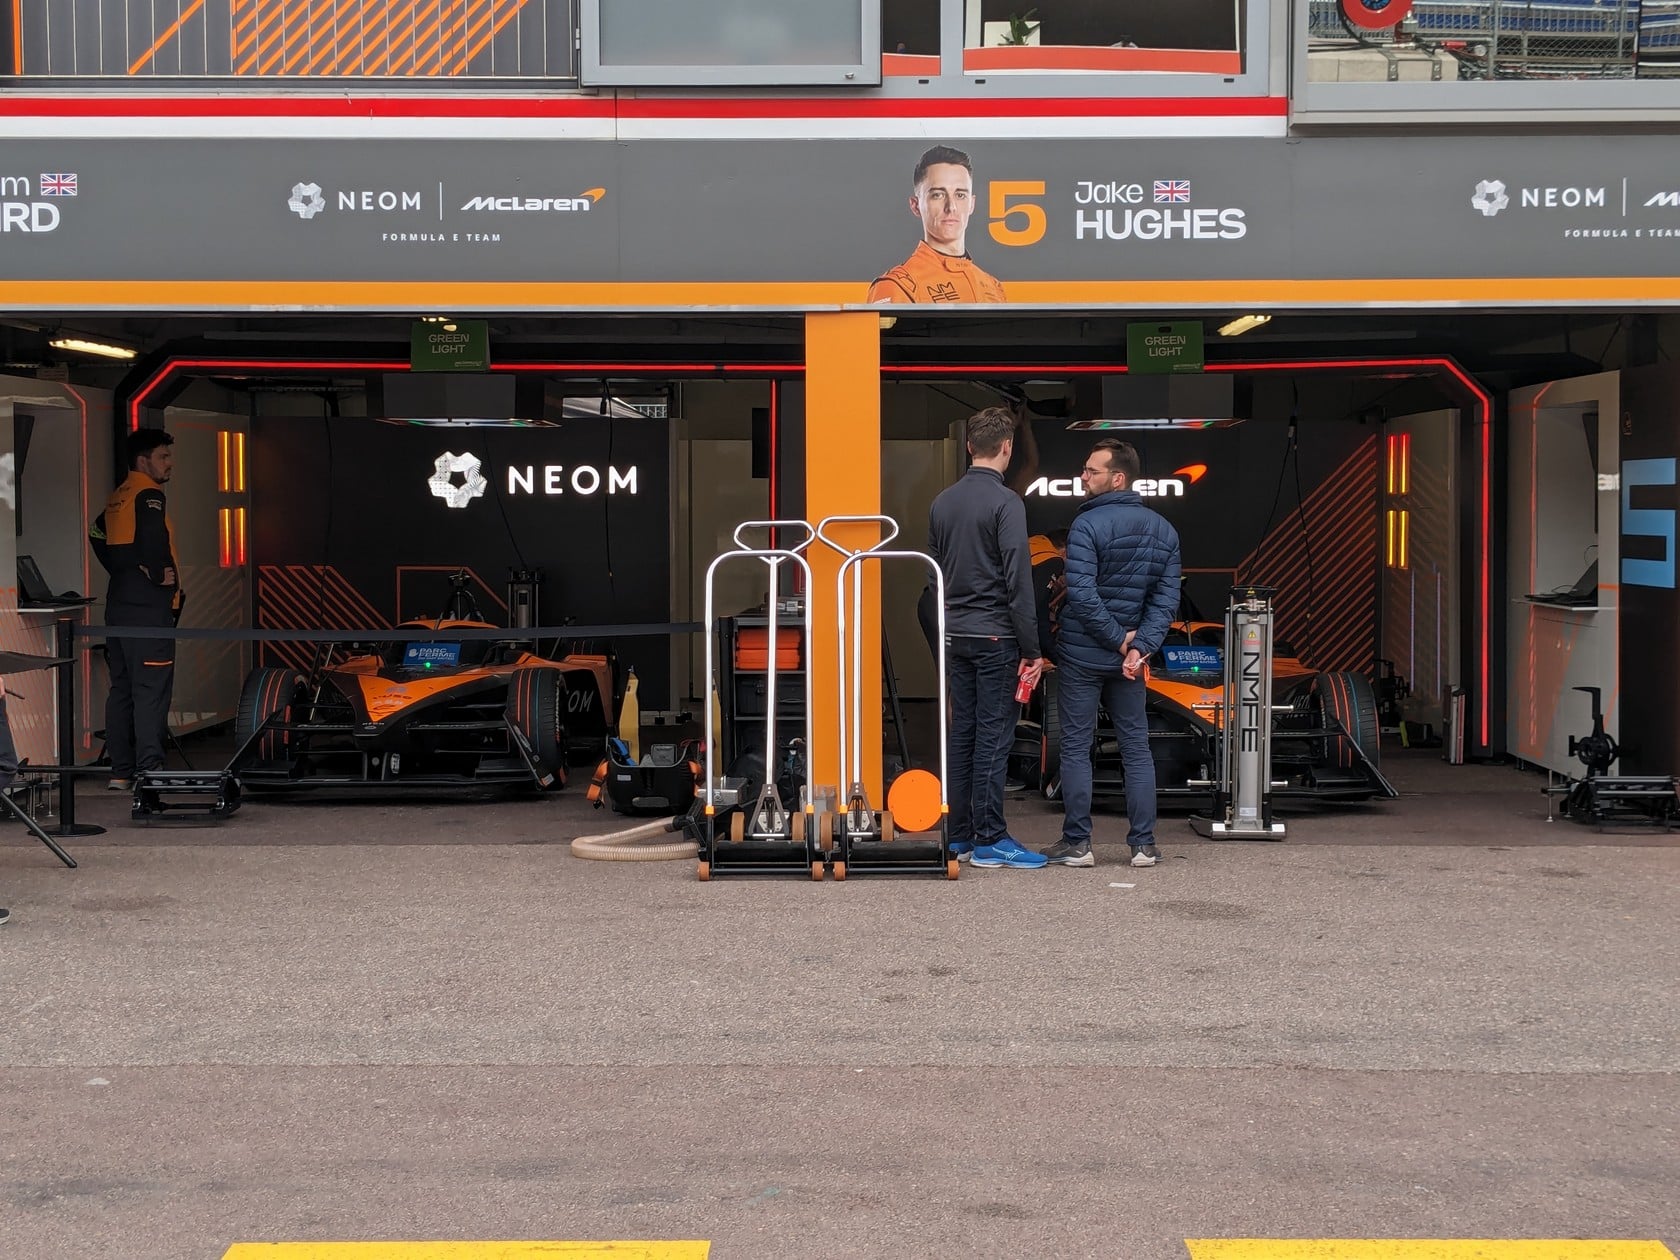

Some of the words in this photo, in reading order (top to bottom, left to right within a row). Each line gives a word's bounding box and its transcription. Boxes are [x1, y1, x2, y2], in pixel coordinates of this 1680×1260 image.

[338, 191, 421, 211] NEOM
[460, 196, 590, 211] McLaren
[1074, 181, 1144, 204] Jake
[1522, 187, 1605, 207] NEOM
[1643, 191, 1680, 207] M
[0, 202, 61, 232] RD
[988, 181, 1048, 247] 5
[1076, 208, 1247, 240] HUGHES
[382, 233, 446, 241] FORMULA
[453, 233, 459, 242] E
[466, 233, 501, 242] TEAM
[1564, 229, 1628, 238] FORMULA
[1635, 229, 1641, 238] E
[428, 333, 470, 343] GREEN
[1144, 335, 1187, 346] GREEN
[431, 344, 466, 354] LIGHT
[1148, 346, 1183, 357] LIGHT
[507, 464, 638, 496] NEOM
[1621, 457, 1677, 589] 5
[1241, 651, 1260, 753] NMFE
